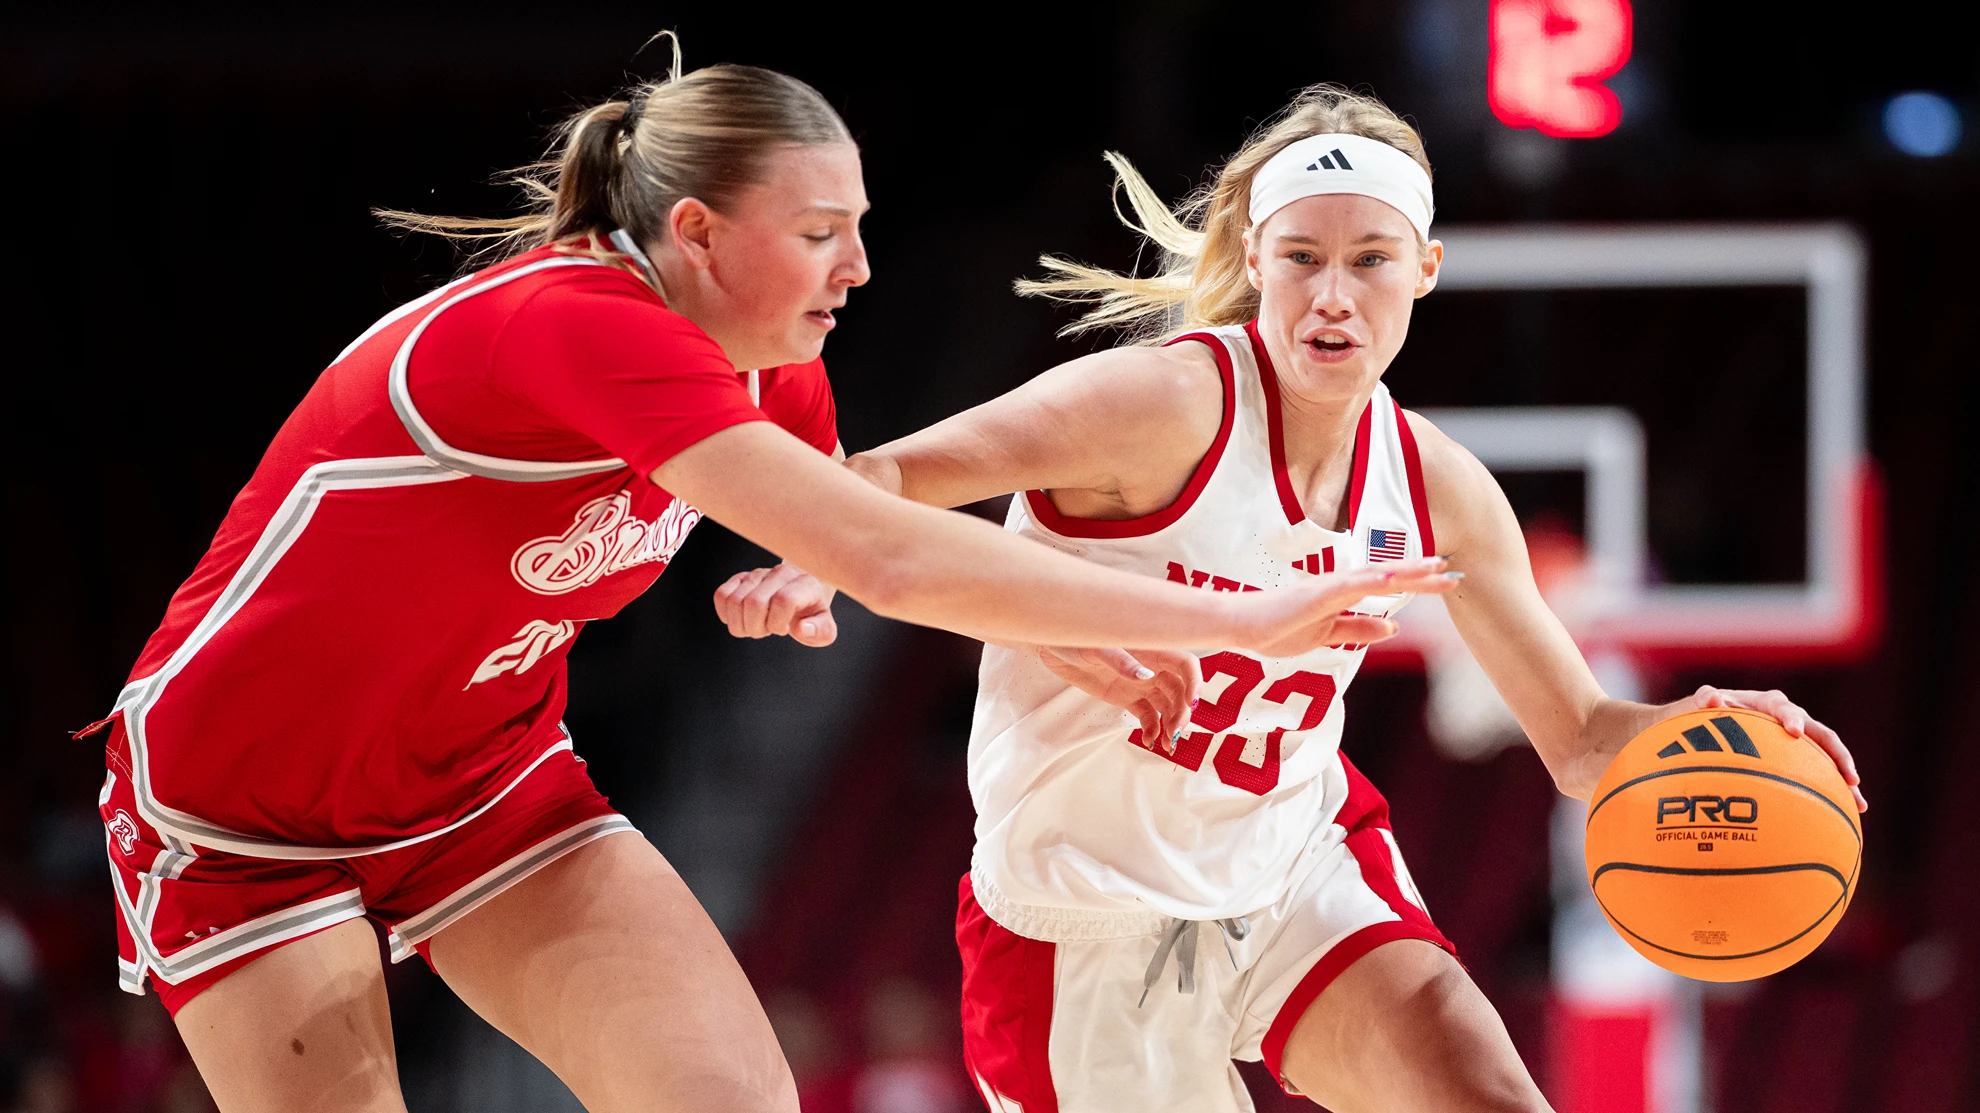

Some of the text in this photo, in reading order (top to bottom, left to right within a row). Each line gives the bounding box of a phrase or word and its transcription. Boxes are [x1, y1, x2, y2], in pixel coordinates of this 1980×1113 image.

[1127, 650, 1337, 797] 23
[1657, 795, 1758, 824] PRO
[1656, 831, 1757, 842] OFFICIAL GAME BALL
